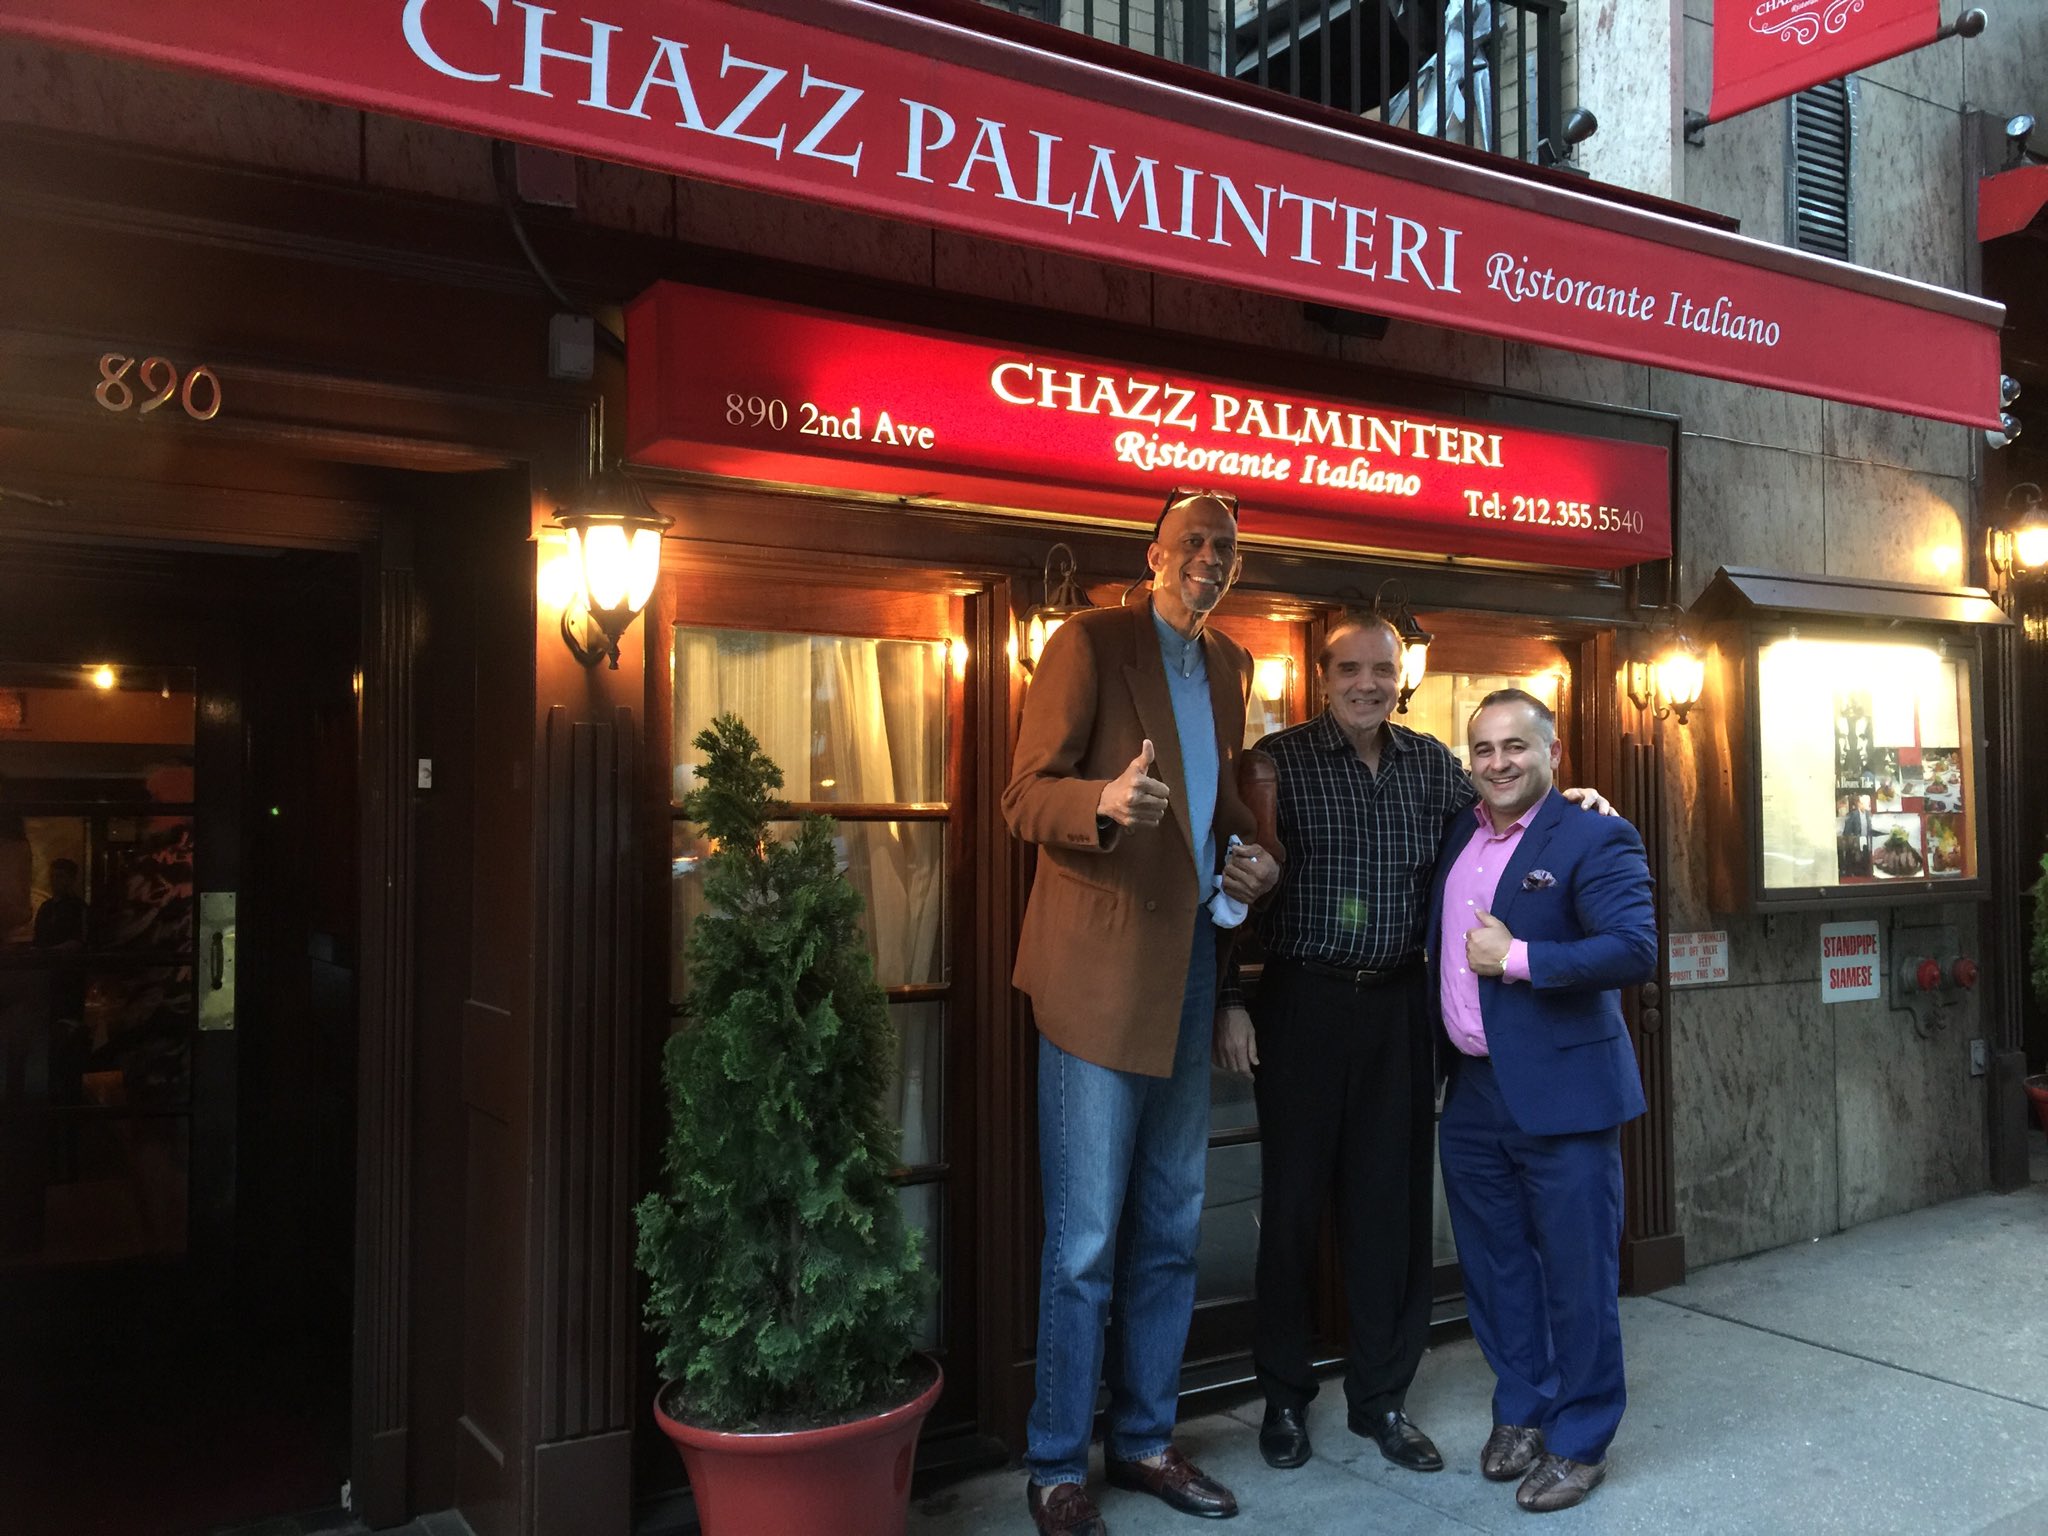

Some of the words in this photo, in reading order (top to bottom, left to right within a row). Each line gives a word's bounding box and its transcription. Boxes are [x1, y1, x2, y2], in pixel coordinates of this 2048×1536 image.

[1756, 0, 1794, 16] CHA
[402, 0, 865, 178] CHAZZ
[897, 98, 1463, 294] PALMINTERI
[1486, 252, 1655, 322] Ristorante
[1664, 291, 1781, 347] Italiano
[95, 353, 222, 420] 890
[991, 362, 1197, 432] CHAZZ
[1210, 393, 1504, 468] PALMINTERI
[726, 393, 788, 431] 890
[799, 402, 863, 440] 2nd
[871, 411, 935, 450] Ave
[1115, 431, 1291, 481] Ristorante
[1299, 454, 1421, 496] Italiano
[1463, 490, 1507, 521] Tel:
[1512, 495, 1643, 535] 212.355.5540
[1823, 934, 1877, 958] STANDPIPE
[1830, 966, 1873, 990] SIAMESE
